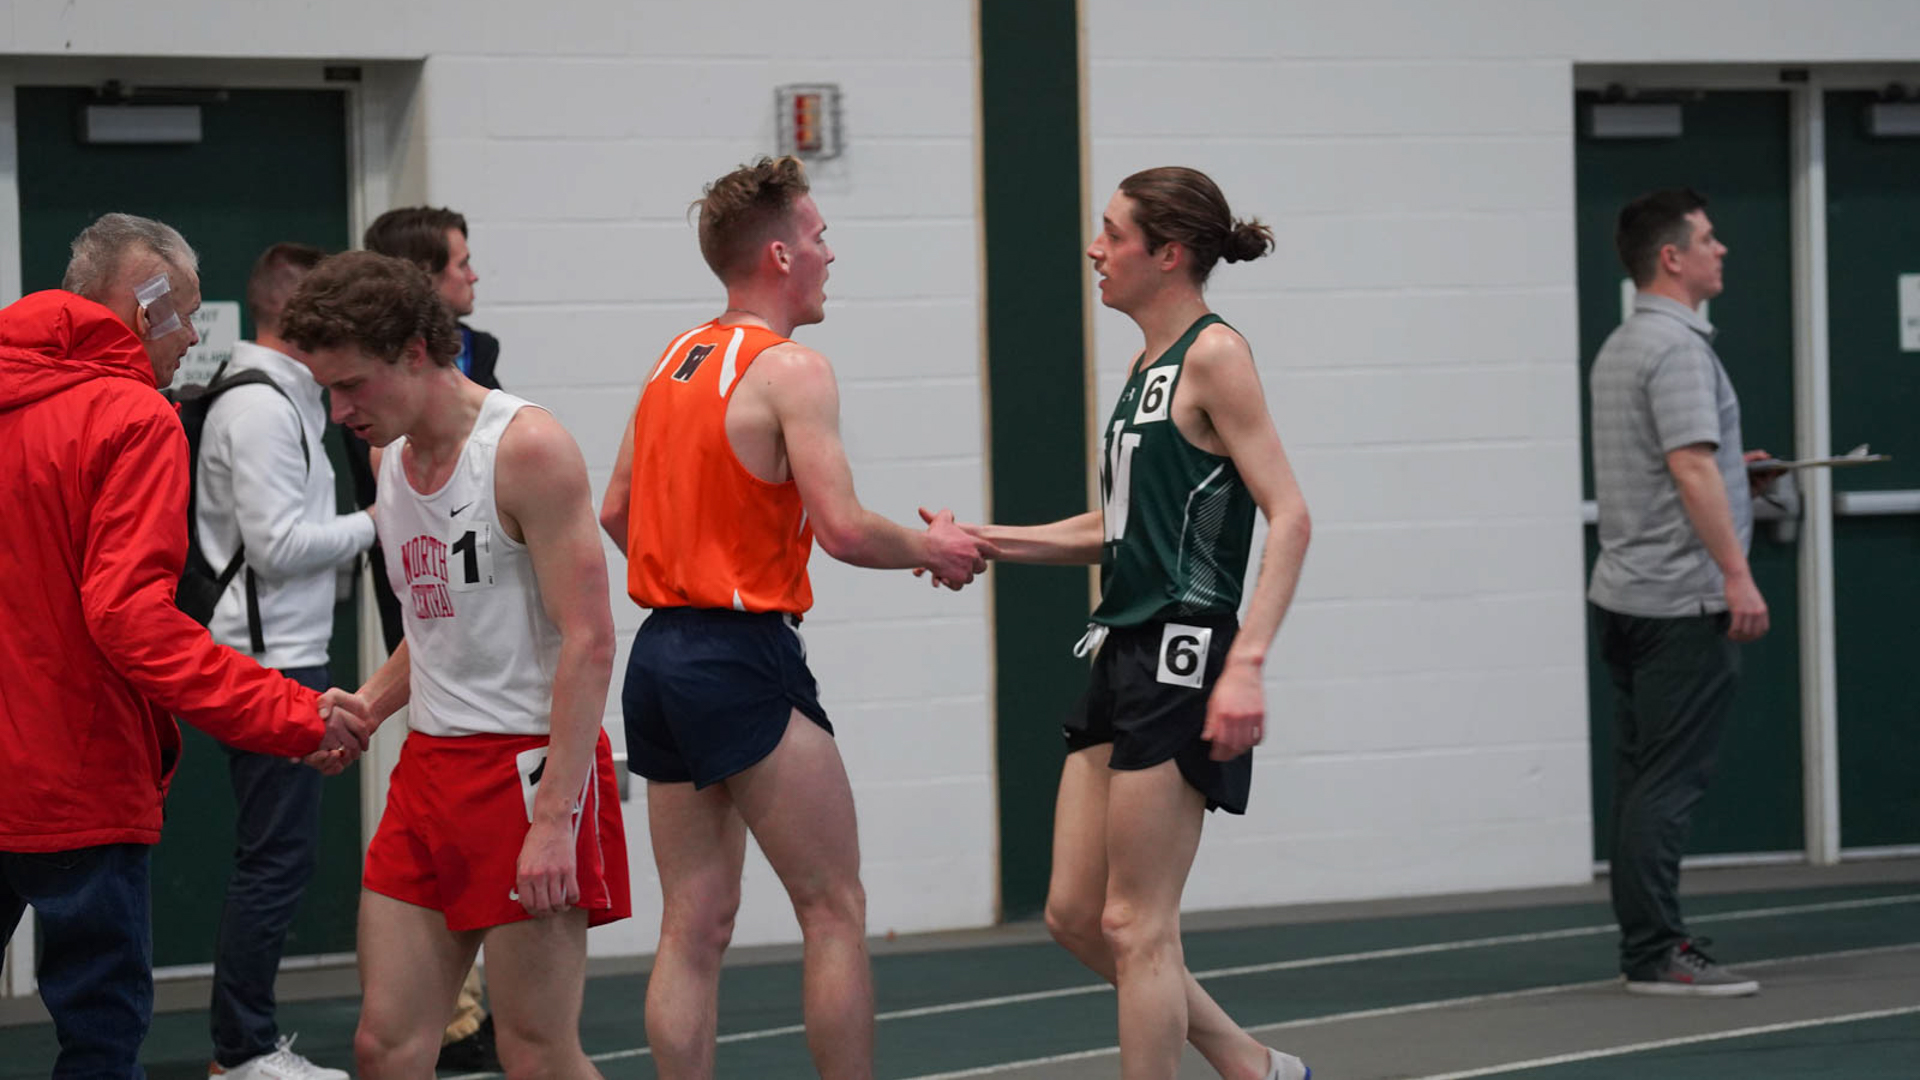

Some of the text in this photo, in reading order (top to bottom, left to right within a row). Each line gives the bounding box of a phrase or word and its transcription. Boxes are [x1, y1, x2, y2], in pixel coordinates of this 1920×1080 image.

[1142, 375, 1167, 413] 6
[401, 534, 448, 585] NORTH
[451, 530, 480, 584] 1
[1165, 634, 1200, 677] 6
